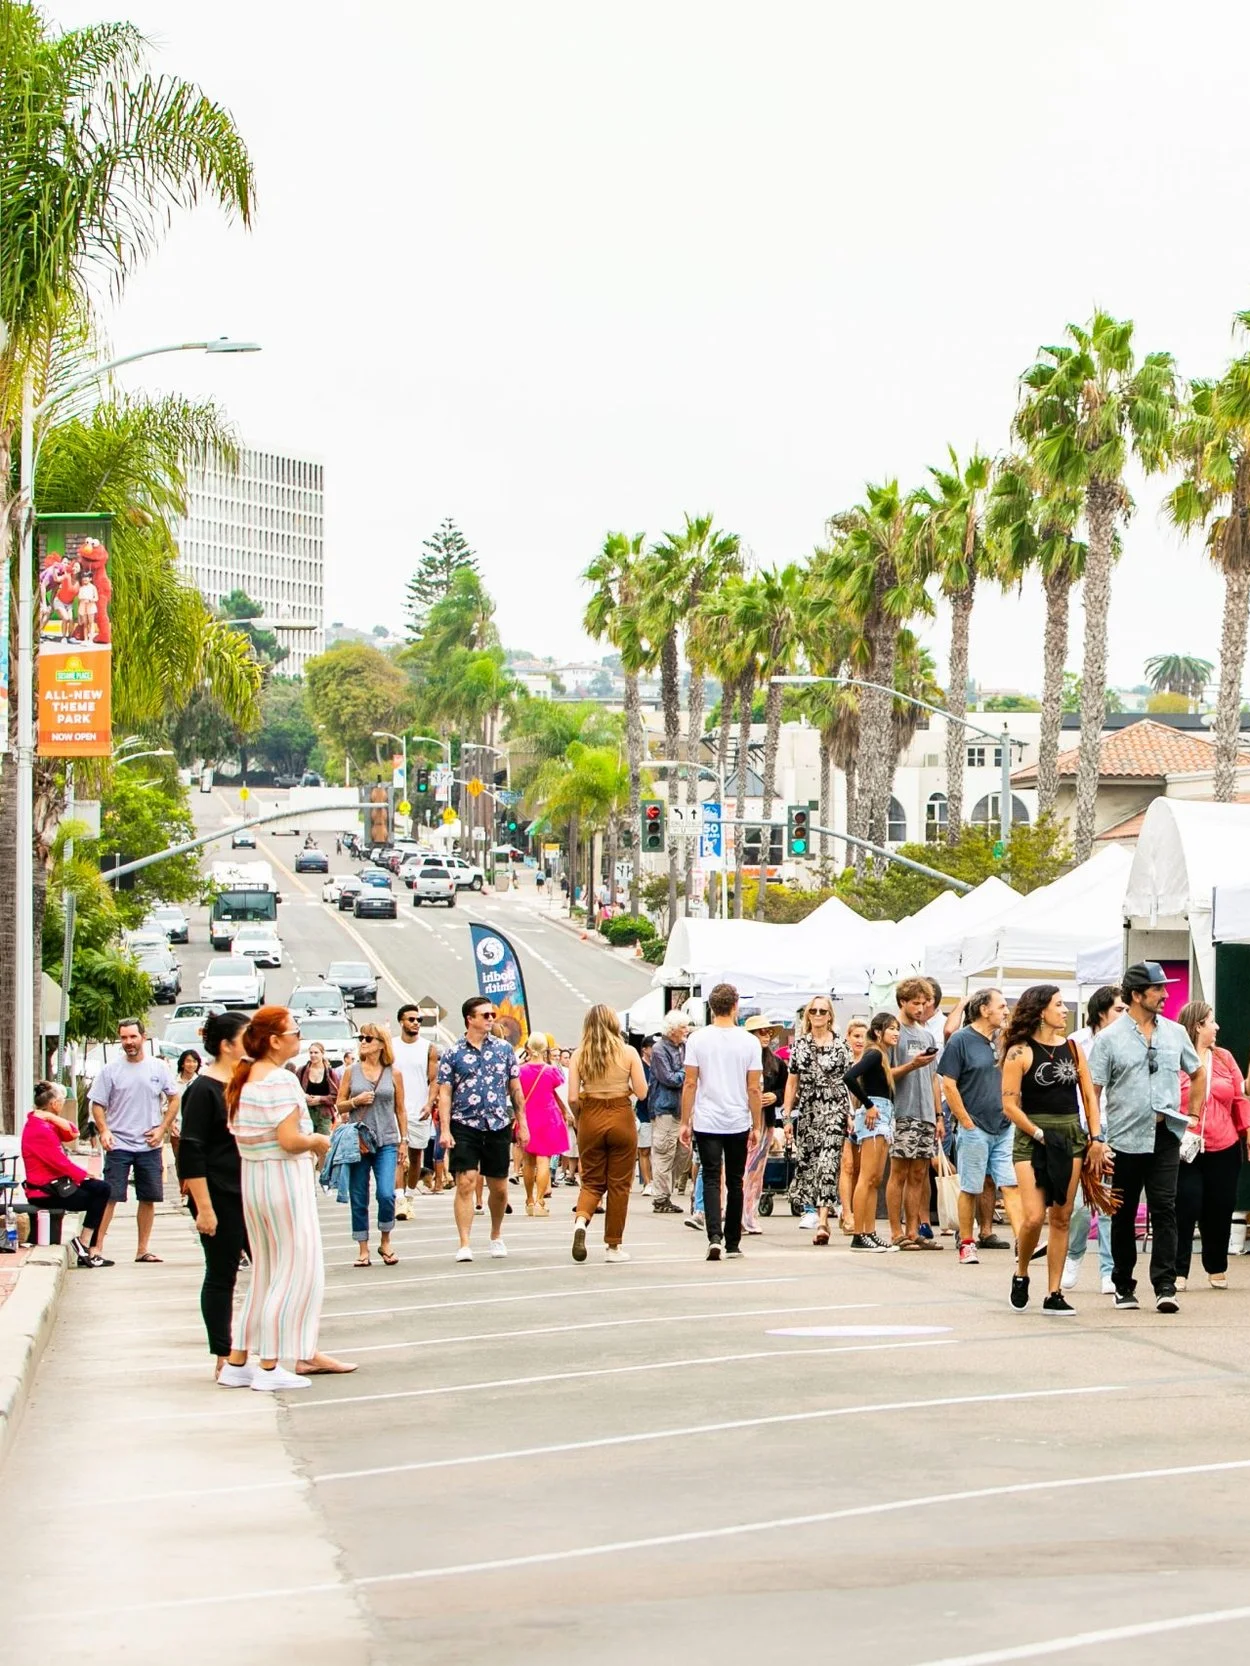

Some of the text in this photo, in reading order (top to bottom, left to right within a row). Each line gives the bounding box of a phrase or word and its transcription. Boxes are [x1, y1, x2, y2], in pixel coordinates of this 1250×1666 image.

[45, 690, 103, 700] ALL-NEW
[52, 702, 96, 712] THEME
[57, 714, 91, 724] PARK
[51, 732, 97, 742] NOW OPEN
[704, 823, 719, 834] 50
